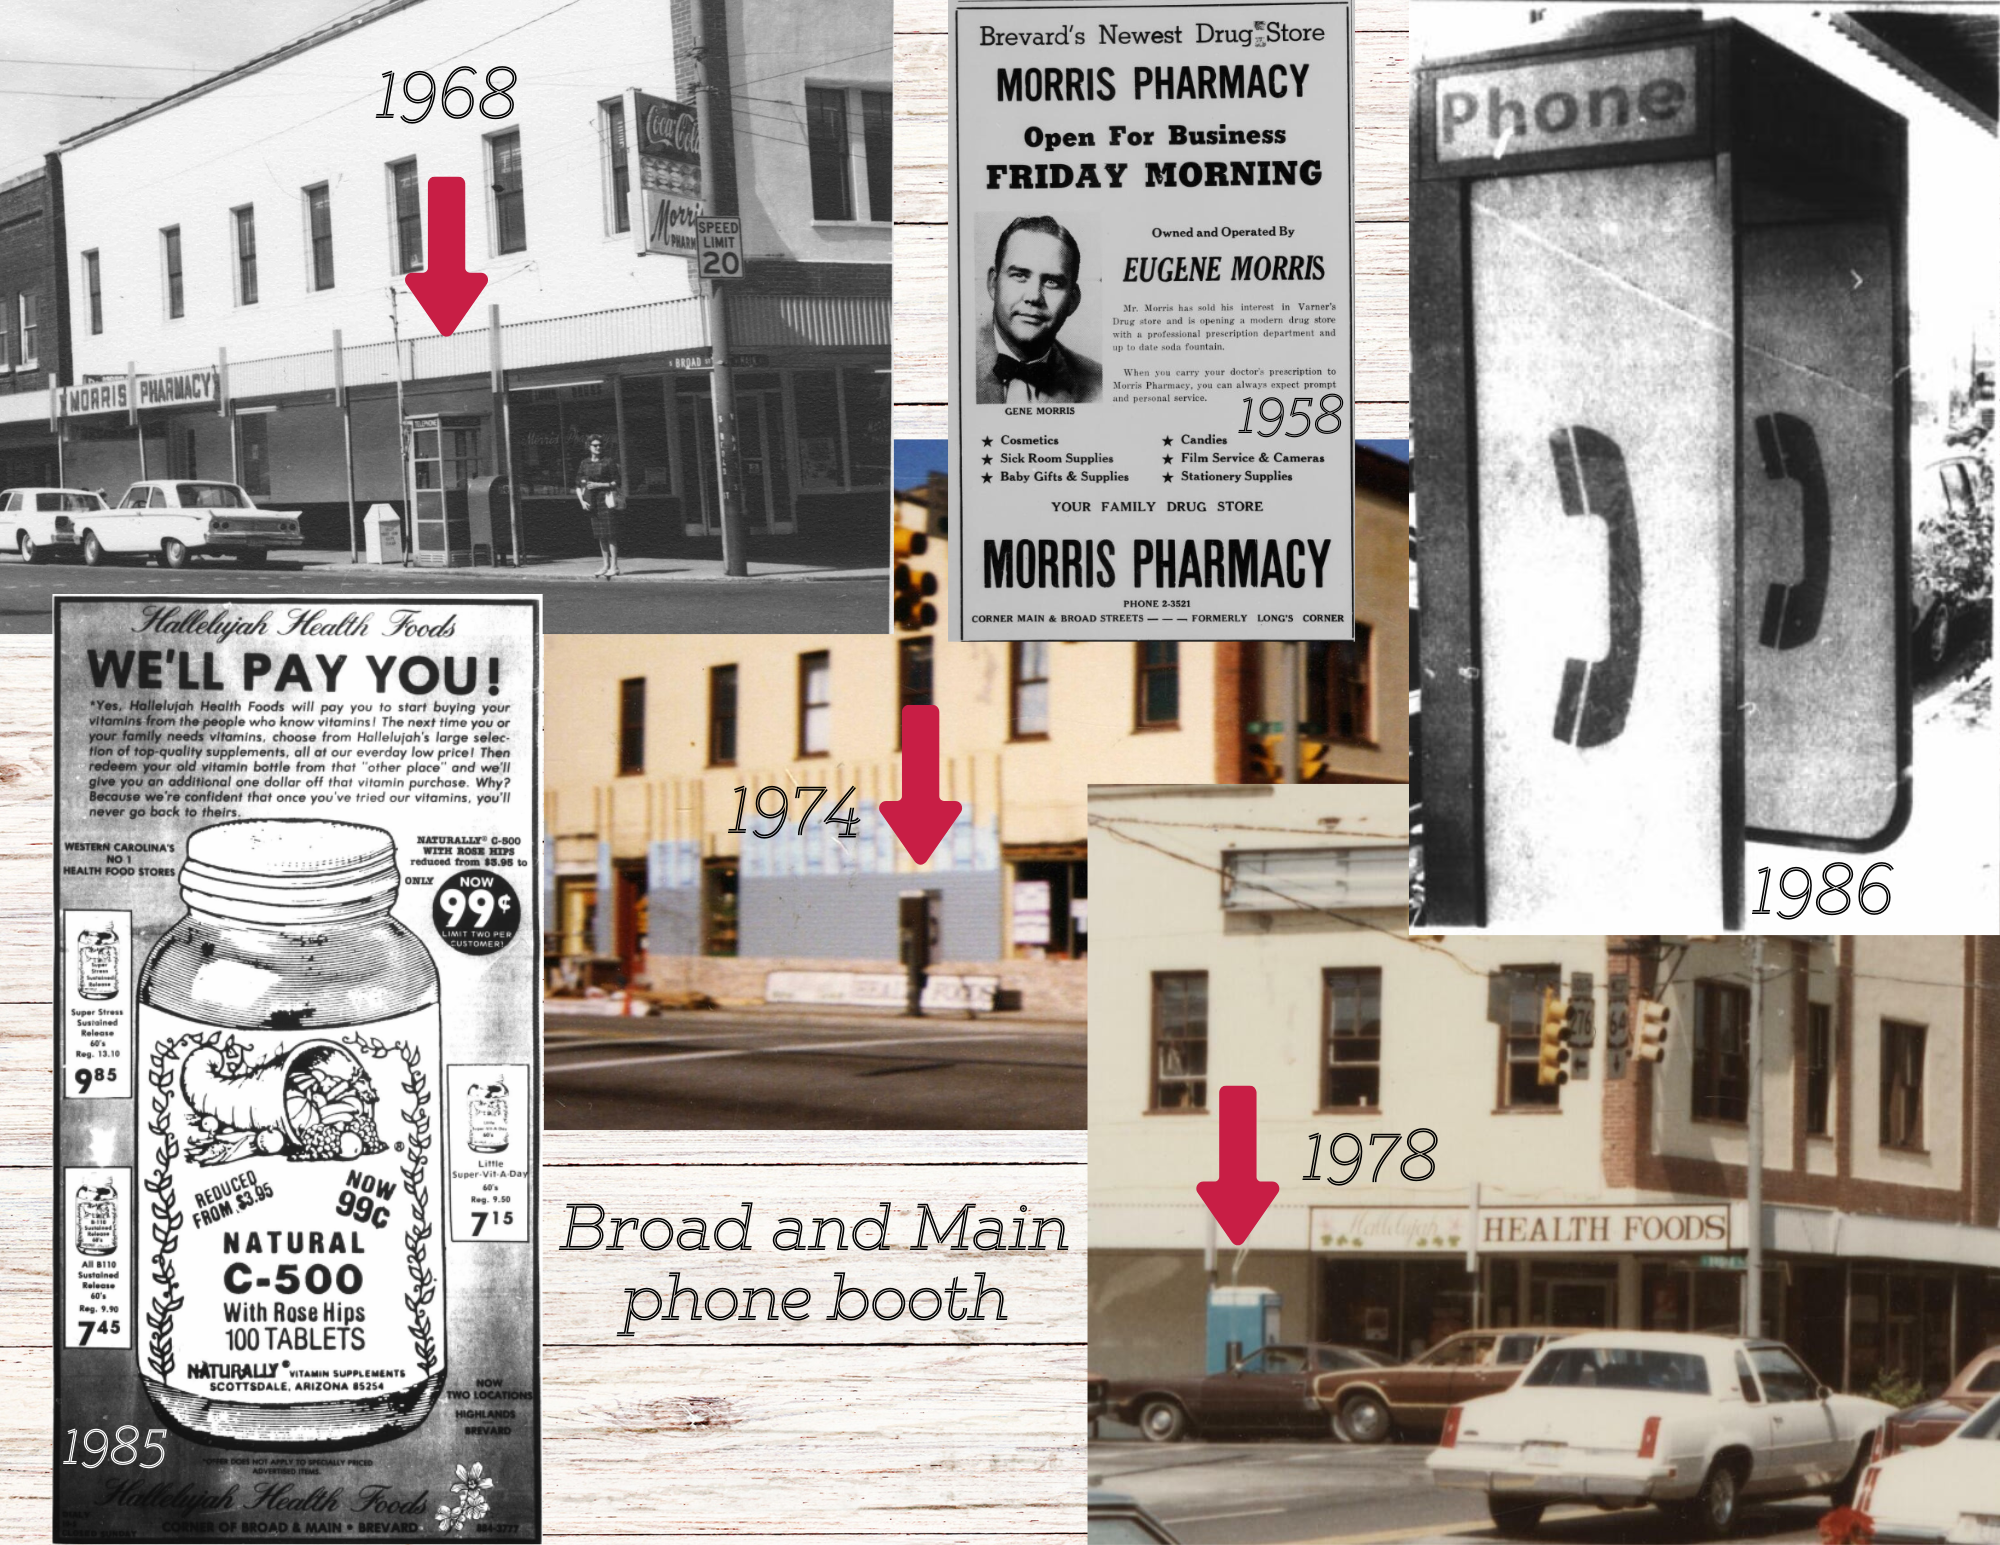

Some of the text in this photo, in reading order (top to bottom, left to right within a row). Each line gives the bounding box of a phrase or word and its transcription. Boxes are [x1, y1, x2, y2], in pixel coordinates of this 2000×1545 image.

[980, 21, 1325, 46] Brevard's Newest Drug Store
[997, 63, 1310, 102] MORRIS PHARMACY
[1442, 76, 1687, 143] Phone
[1024, 124, 1286, 152] Open For Business
[986, 159, 1322, 190] FRIDAY MORNING
[651, 199, 704, 245] Morri
[698, 222, 739, 233] SPEED
[1152, 226, 1295, 239] Owned and Operated By
[671, 234, 697, 251] PHARM
[703, 237, 734, 248] LIMIT
[703, 252, 739, 275] 20
[1122, 255, 1325, 283] EUGENE MORRIS
[675, 357, 701, 368] BROAD
[70, 372, 211, 413] MORRIS PHARMACY
[1005, 407, 1075, 415] GENE MORRIS
[1001, 435, 1059, 445] Cosmetics
[1181, 434, 1228, 445] Candies
[1000, 453, 1114, 465] Sick Room Supplies
[1181, 452, 1325, 463] Film Service & Cameras
[1000, 471, 1129, 483] Baby Gifts & Supplies
[1181, 470, 1293, 483] Stationery Supplies
[1051, 501, 1263, 512] YOUR FAMILY DRUG STORE
[984, 539, 1331, 589] MORRIS PHARMACY
[1123, 600, 1159, 608] PHONE
[131, 605, 457, 643] Hallelujah Health Foods
[972, 615, 1013, 623] CORNER
[1017, 614, 1044, 622] MAIN
[1100, 614, 1144, 622] STREETS
[1192, 614, 1344, 623] FORMERLY LONG'S CORNER
[87, 649, 501, 696] WE'LL PAY YOU!
[491, 837, 521, 845] C-500
[64, 841, 175, 854] WESTERN CAROLINA'S
[423, 847, 452, 855] WITH
[457, 847, 485, 855] ROSE
[107, 855, 131, 864] NO 1
[455, 858, 480, 866] from
[63, 866, 176, 878] HEALTH FOOD STORES
[405, 877, 434, 885] ONLY
[460, 877, 494, 887] NOW
[440, 889, 511, 928] 99¢
[71, 1008, 124, 1017] Super Stress
[77, 1019, 118, 1027] Sustained
[81, 1029, 114, 1037] Release
[90, 1039, 106, 1047] 60's
[76, 1050, 120, 1059] Reg. 13.10
[195, 1169, 256, 1208] REDUCED
[346, 1169, 397, 1201] NOW
[471, 1196, 489, 1205] Reg.
[192, 1203, 234, 1229] FROM
[1484, 1217, 1610, 1242] HEALTH
[1623, 1214, 1727, 1240] FOODS
[223, 1231, 365, 1255] NATURAL
[223, 1262, 364, 1295] C-500
[223, 1302, 365, 1326] With Rose Hips
[225, 1326, 366, 1351] 100 TABLETS
[187, 1360, 406, 1380] NATURALLY VITAMIN SUPPLEMENTS
[210, 1381, 385, 1393] SCOTTSDALE, ARIZONA 85254
[475, 1378, 503, 1389] NOW
[447, 1390, 534, 1401] TWO LOCATIONS
[455, 1409, 516, 1420] HIGHLANDS
[465, 1426, 512, 1436] BREVARD
[161, 1521, 418, 1535] CORNER OF BROAD & MAIN BREVARD
